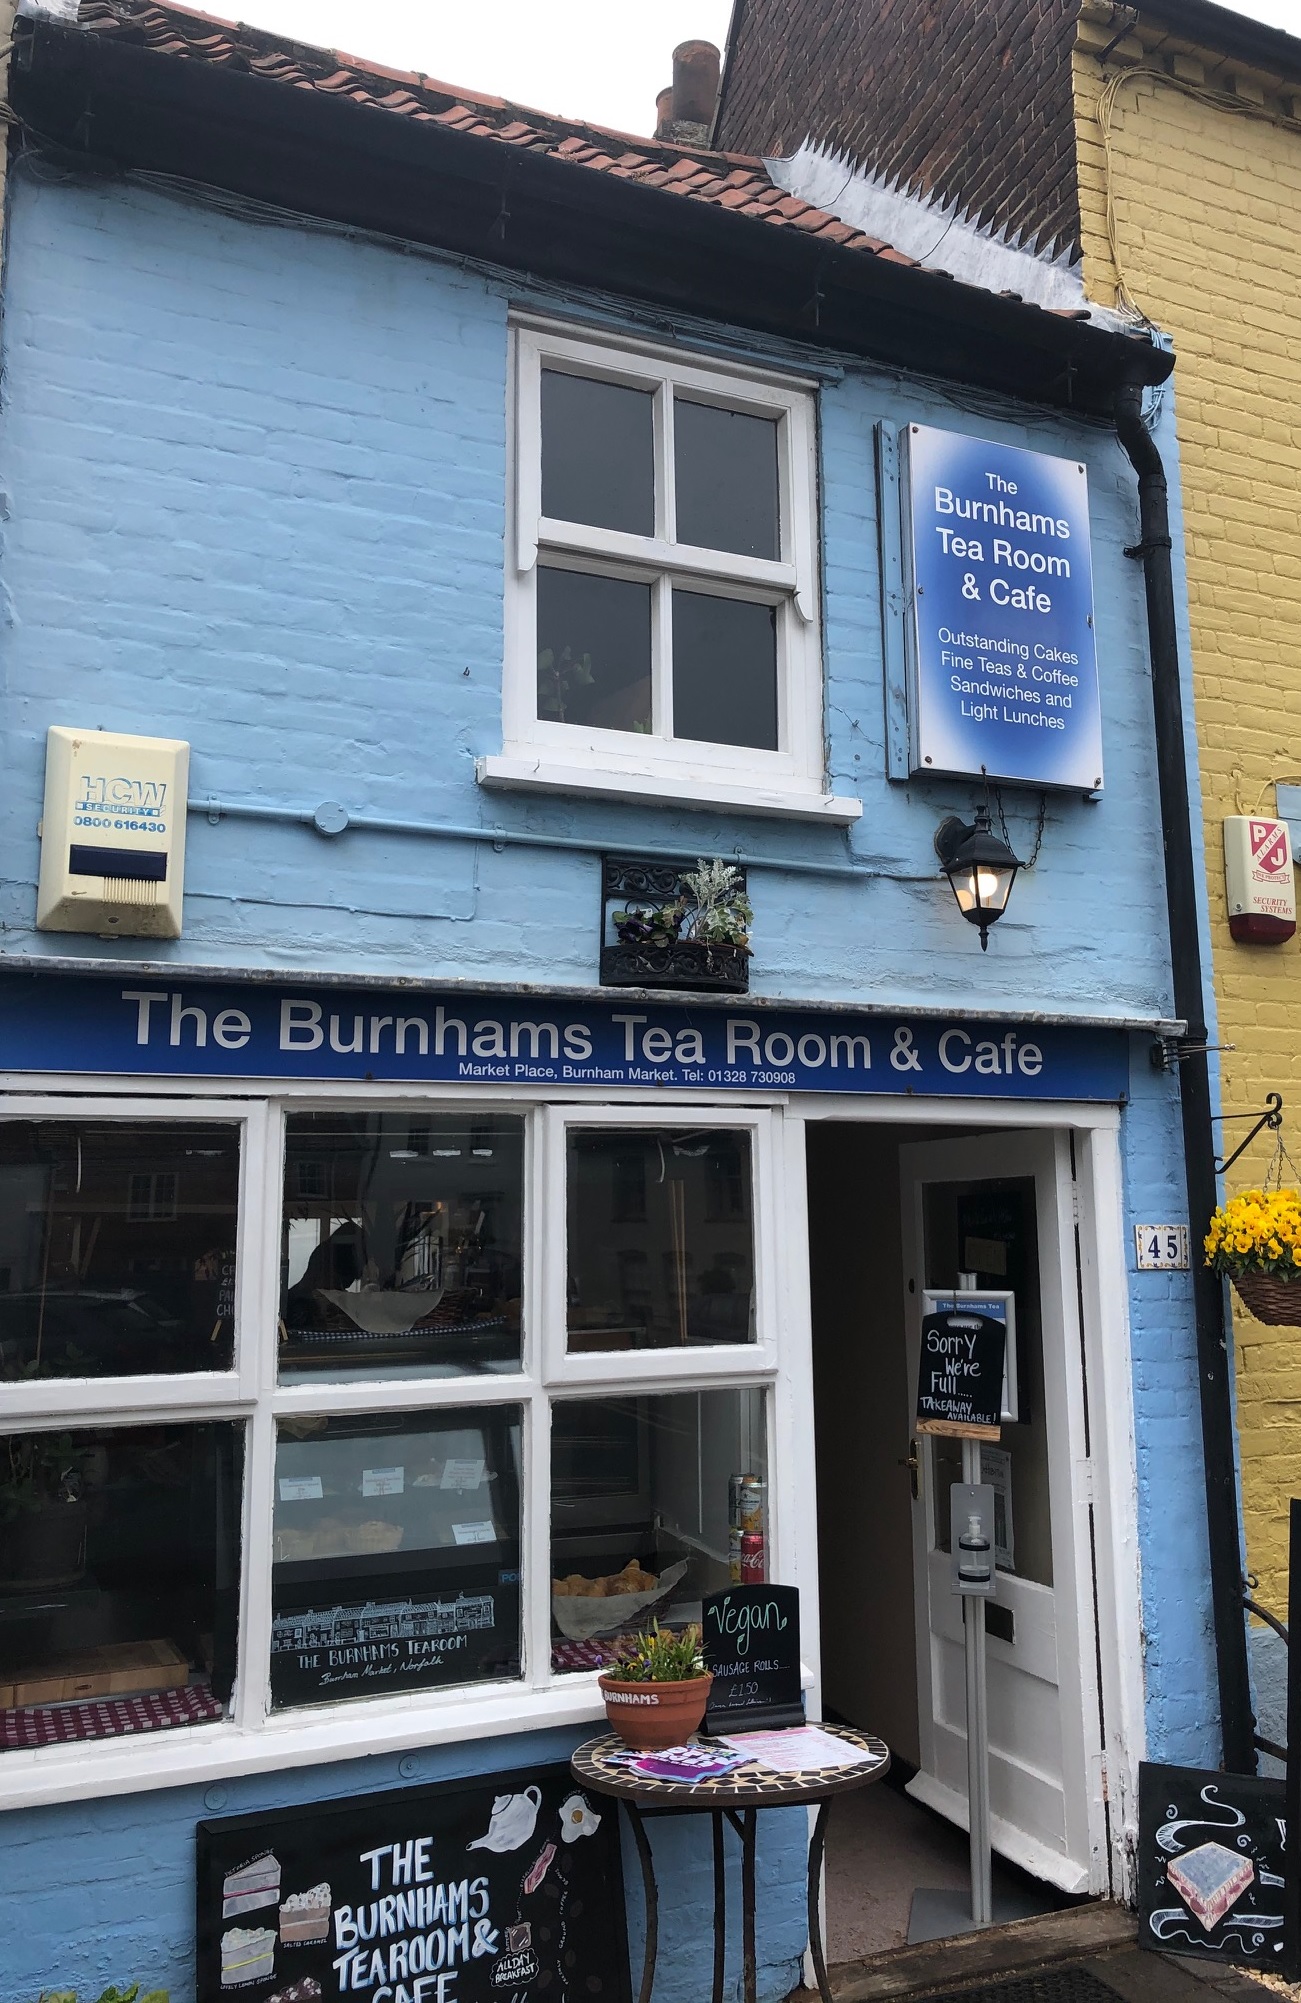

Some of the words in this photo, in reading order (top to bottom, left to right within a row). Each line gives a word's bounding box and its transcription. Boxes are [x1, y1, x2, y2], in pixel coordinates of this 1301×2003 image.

[985, 472, 1018, 495] The
[935, 486, 1070, 539] Burnhams
[935, 526, 984, 562] Tea
[993, 539, 1070, 578] Room
[961, 572, 981, 601] &
[989, 578, 1052, 614] Cafe
[938, 627, 1029, 660] Outstanding
[1033, 644, 1079, 665] Cakes
[941, 651, 973, 670] Fine
[977, 657, 1012, 677] Teas
[1017, 662, 1027, 679] &
[1031, 664, 1079, 687] Coffee
[950, 675, 1041, 703] Sandwiches
[1045, 693, 1072, 709] and
[960, 700, 998, 722] Light
[1003, 706, 1065, 730] Lunches
[80, 776, 167, 807] HCW
[74, 815, 112, 829] 0800
[114, 819, 166, 833] 616430
[86, 803, 150, 815] SECURITY
[1252, 824, 1267, 842] P
[1256, 826, 1283, 860] ALARMS
[1271, 848, 1284, 866] J
[1253, 897, 1287, 906] SECURITY
[1261, 906, 1292, 914] SYSTEMS
[121, 990, 251, 1049] The
[279, 998, 592, 1060] Burnhams
[611, 1014, 705, 1063] Tea
[726, 1019, 872, 1069] Room
[889, 1026, 924, 1071] &
[938, 1028, 1043, 1076] Cafe
[458, 1062, 510, 1077] Market
[515, 1063, 558, 1079] Place,
[562, 1065, 624, 1079] Burnham
[628, 1067, 678, 1082] Market.
[682, 1069, 704, 1082] Tel:
[708, 1069, 747, 1083] 01328
[750, 1071, 796, 1084] 730908
[1147, 1234, 1178, 1259] 45
[927, 1329, 976, 1359] Sorry
[945, 1357, 981, 1377] We're
[920, 1396, 972, 1414] TAKEAWAY
[708, 1597, 788, 1655] Vegan
[297, 1654, 320, 1669] THE
[329, 1641, 399, 1668] BURNHAMS
[406, 1634, 468, 1655] TEAROOM
[319, 1671, 359, 1686] Burnham
[400, 1655, 444, 1671] Norfolk
[712, 1661, 749, 1678] SAUSAGE
[604, 1689, 660, 1705] BURNHAMS
[360, 1836, 434, 1891] THE
[334, 1876, 490, 1950] BURNHAMS
[332, 1922, 470, 1991] TEAROOM
[497, 1958, 513, 1972] ALL
[513, 1952, 530, 1969] DAY
[495, 1962, 535, 1984] BREAKFAST
